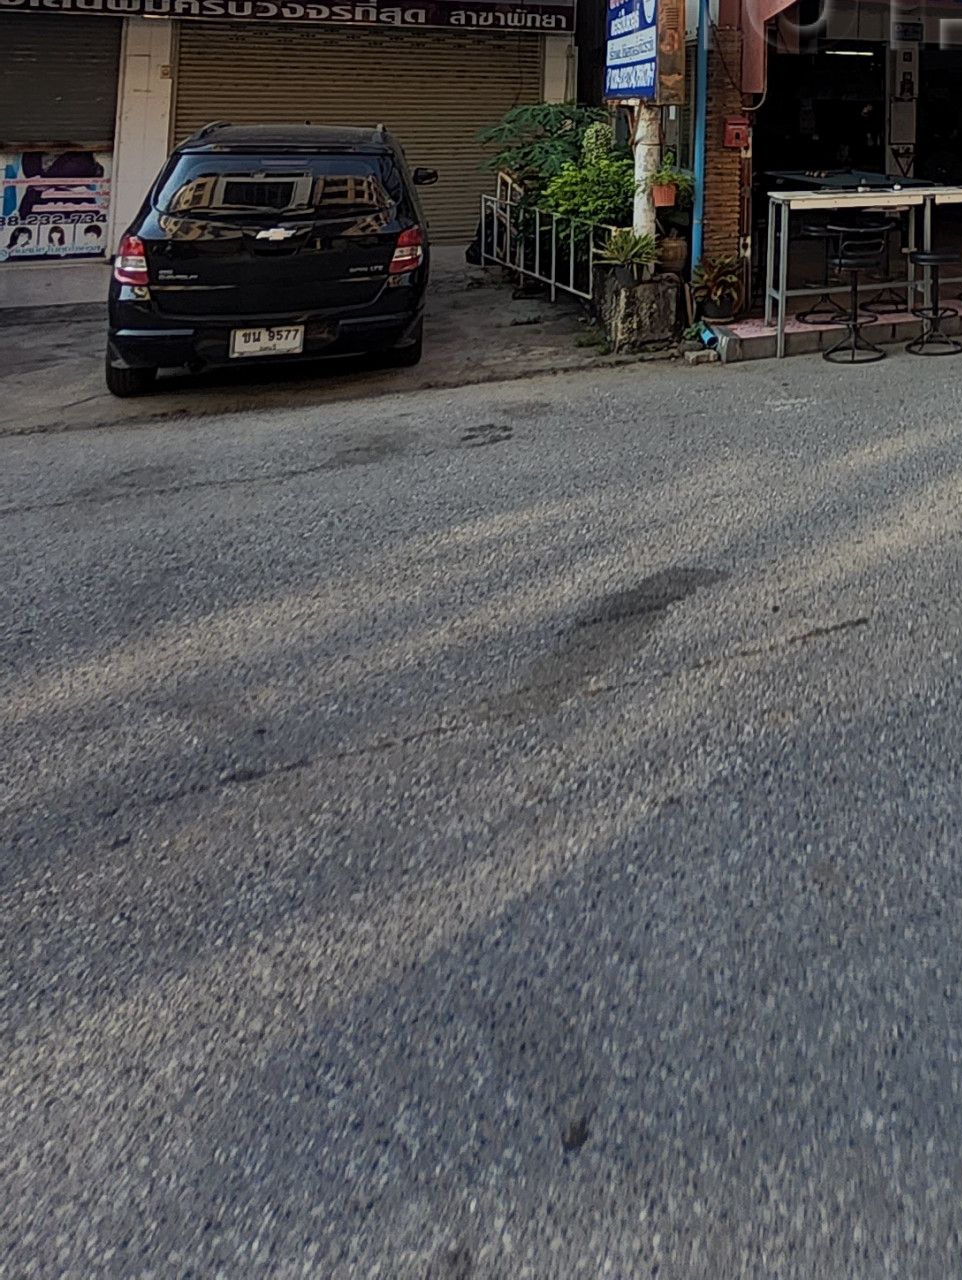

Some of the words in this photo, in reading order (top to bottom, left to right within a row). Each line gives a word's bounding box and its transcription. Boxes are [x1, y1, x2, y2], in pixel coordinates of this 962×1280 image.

[449, 8, 567, 29] สาขาพัทยา
[267, 329, 300, 342] 9577
